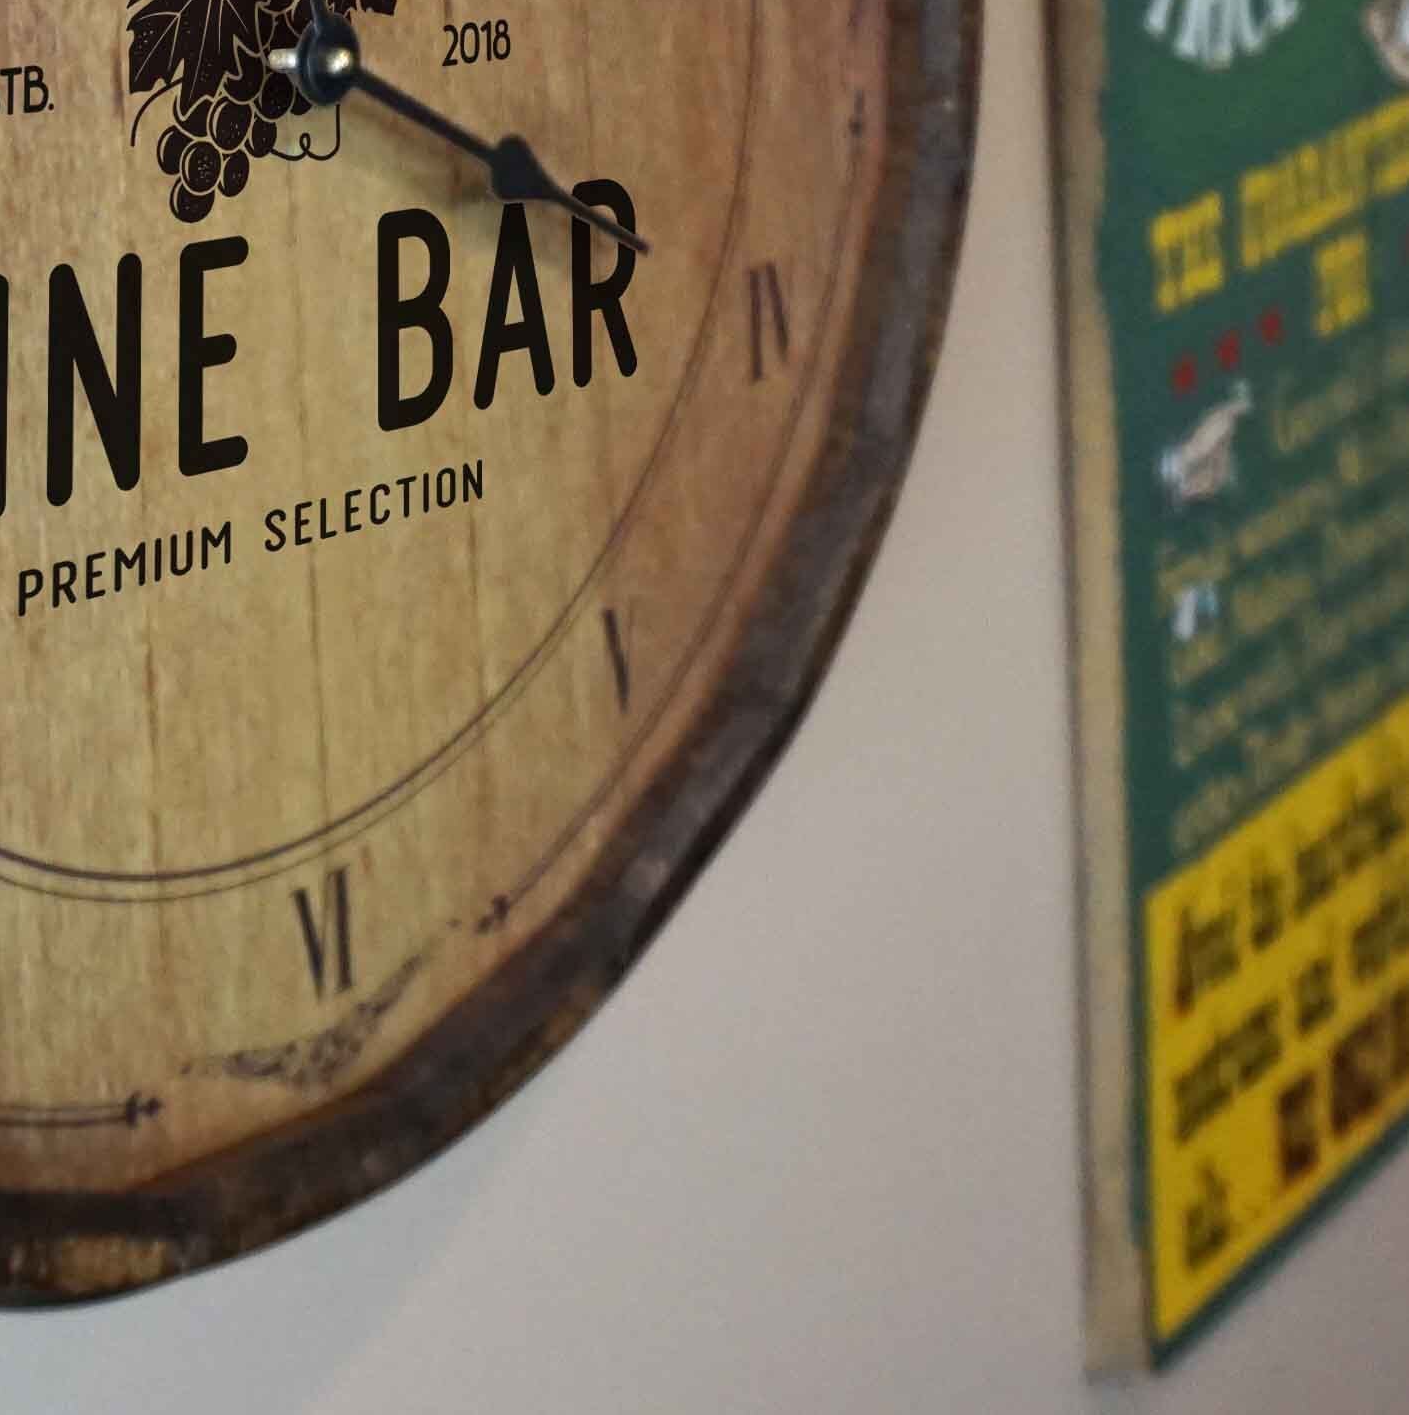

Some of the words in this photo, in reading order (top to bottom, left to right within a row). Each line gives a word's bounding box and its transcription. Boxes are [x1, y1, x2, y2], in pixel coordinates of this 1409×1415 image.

[441, 19, 511, 67] 2018
[377, 178, 639, 433] BAR
[18, 521, 232, 617] PREMIUM
[264, 459, 484, 553] SELECTION
[293, 865, 354, 998] VI
